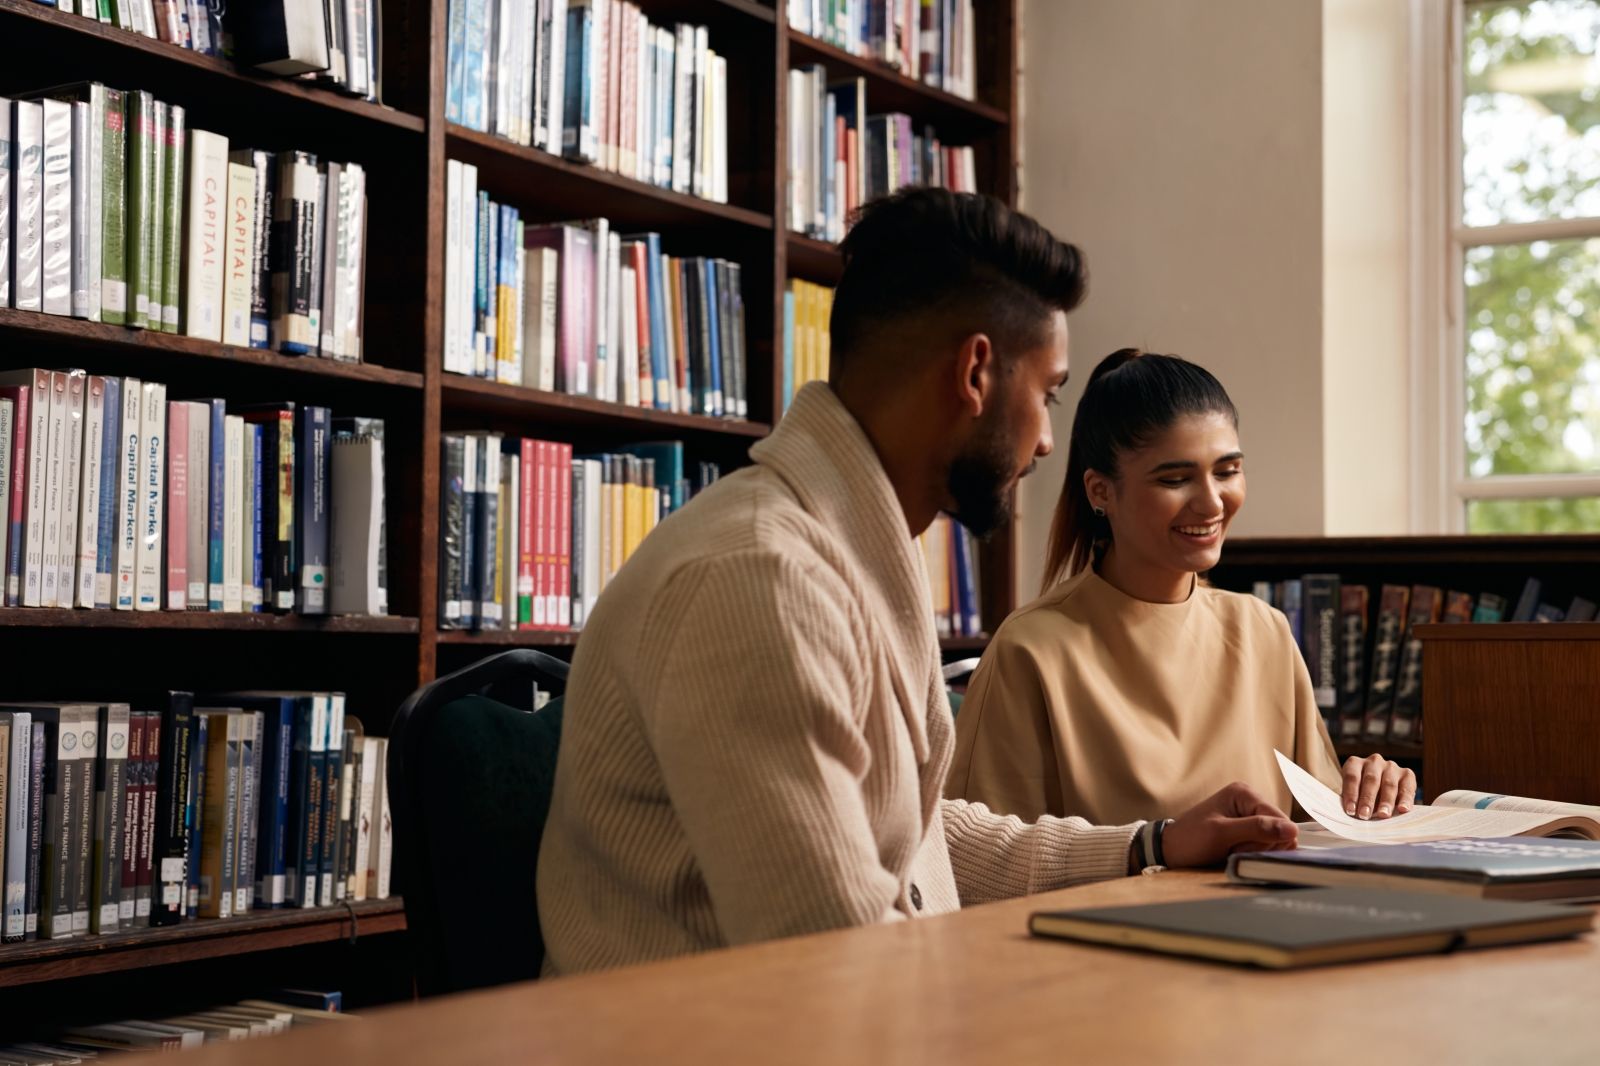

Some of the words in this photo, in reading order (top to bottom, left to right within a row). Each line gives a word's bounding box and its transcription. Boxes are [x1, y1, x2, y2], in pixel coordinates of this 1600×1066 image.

[203, 178, 217, 268] CAPITAL
[233, 197, 248, 279] CAPITAL
[0, 409, 9, 434] Global
[128, 434, 138, 484] Capital
[149, 436, 160, 486] Capital
[126, 489, 136, 550] Markets
[148, 491, 159, 552] Markes
[180, 728, 189, 755] Money
[33, 774, 41, 818] OFFSHORE
[62, 764, 71, 825] INTERNATIONAL
[82, 763, 90, 823] INTERNATIONAL
[111, 764, 120, 824] INTERNATIONAL
[179, 774, 187, 802] Capital
[31, 819, 40, 850] WORLD
[125, 800, 133, 832] Emerging
[142, 799, 150, 831] Emerging
[227, 798, 235, 839] FINANCIAL
[61, 827, 69, 860] FINANCE
[110, 826, 118, 859] FINANCE
